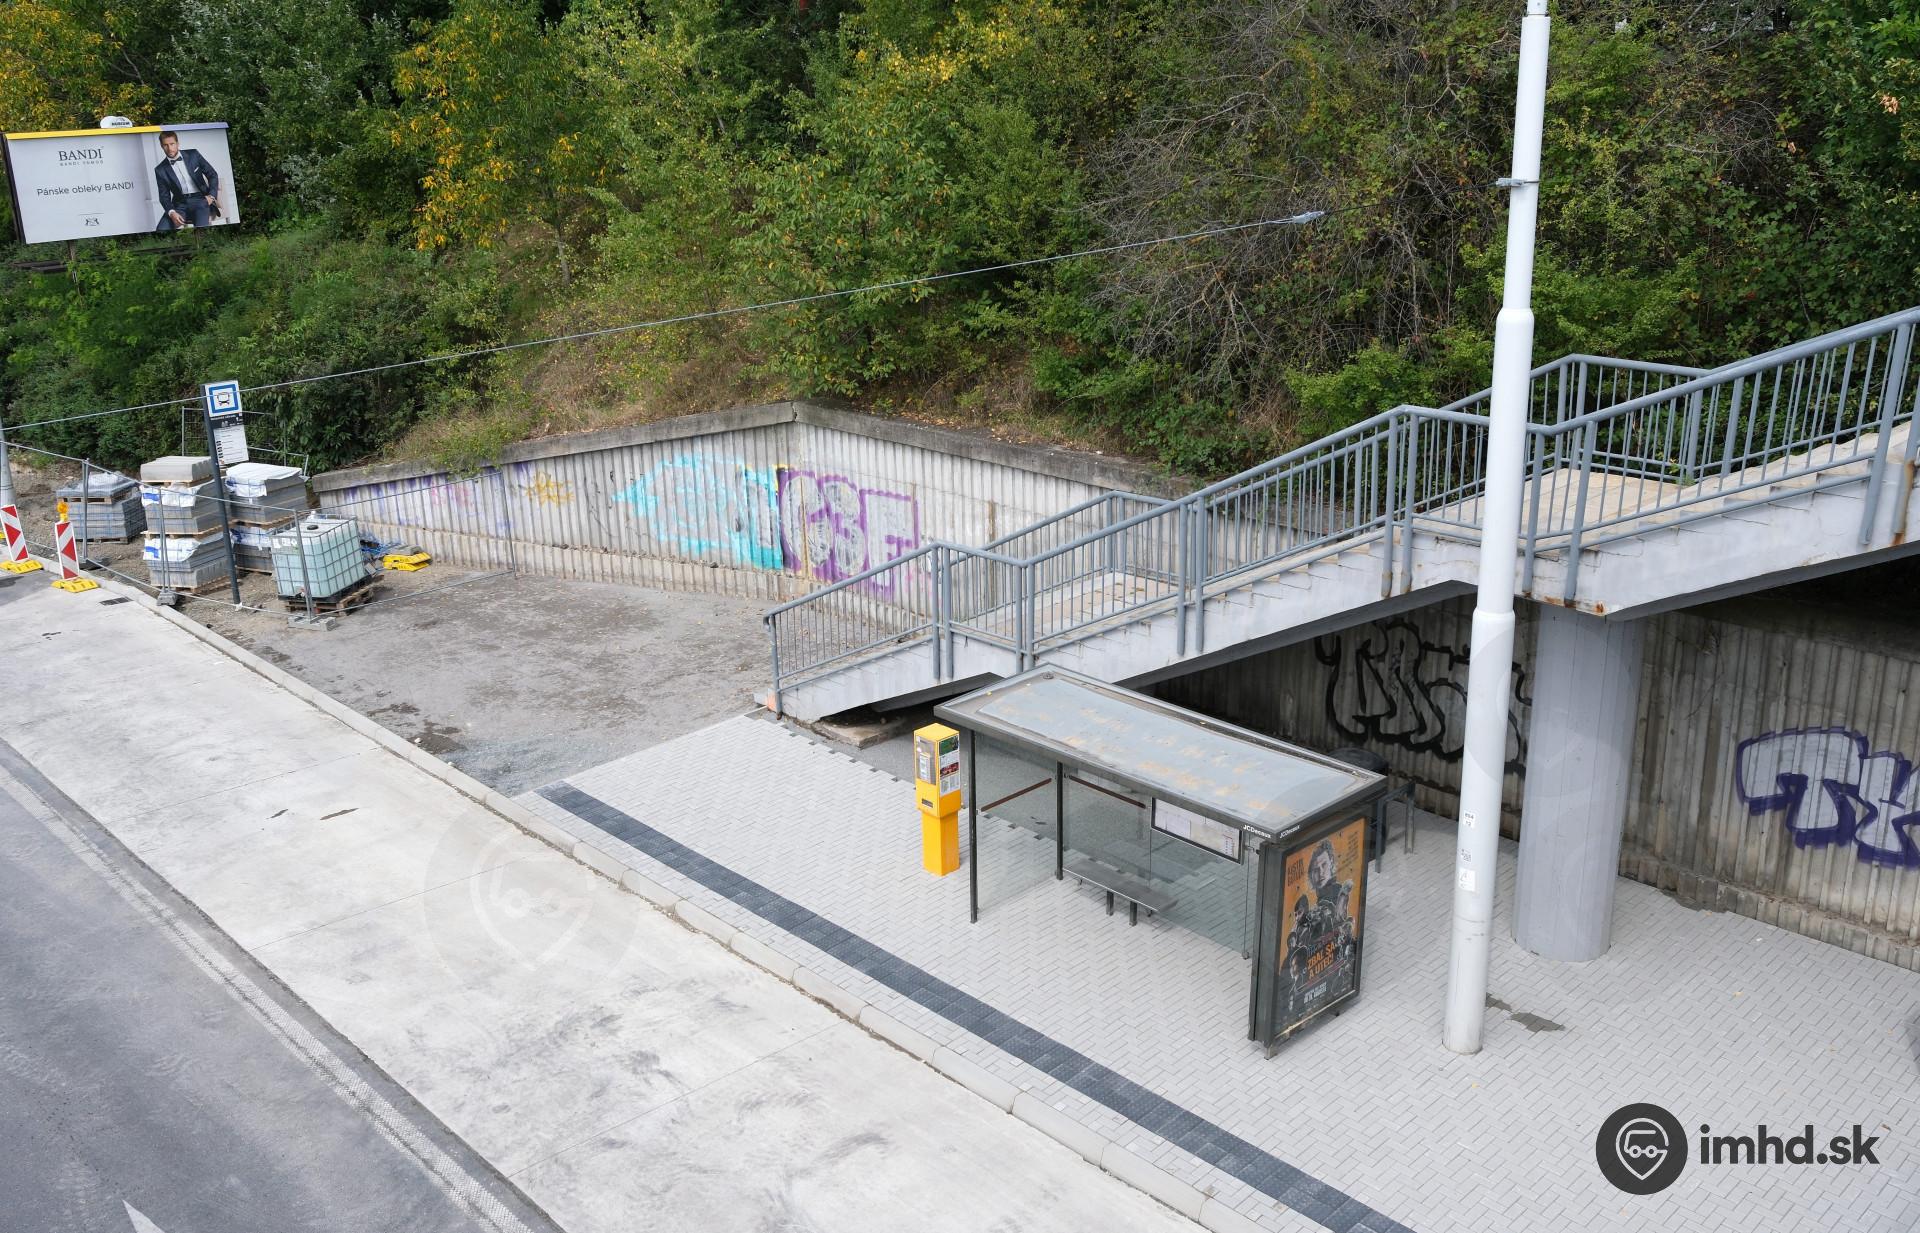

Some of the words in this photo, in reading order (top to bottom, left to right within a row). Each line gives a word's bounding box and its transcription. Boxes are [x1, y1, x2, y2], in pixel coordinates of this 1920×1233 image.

[58, 148, 104, 161] BANDI
[37, 186, 69, 196] Pánske
[72, 184, 102, 194] obleky
[104, 181, 134, 191] BANDI
